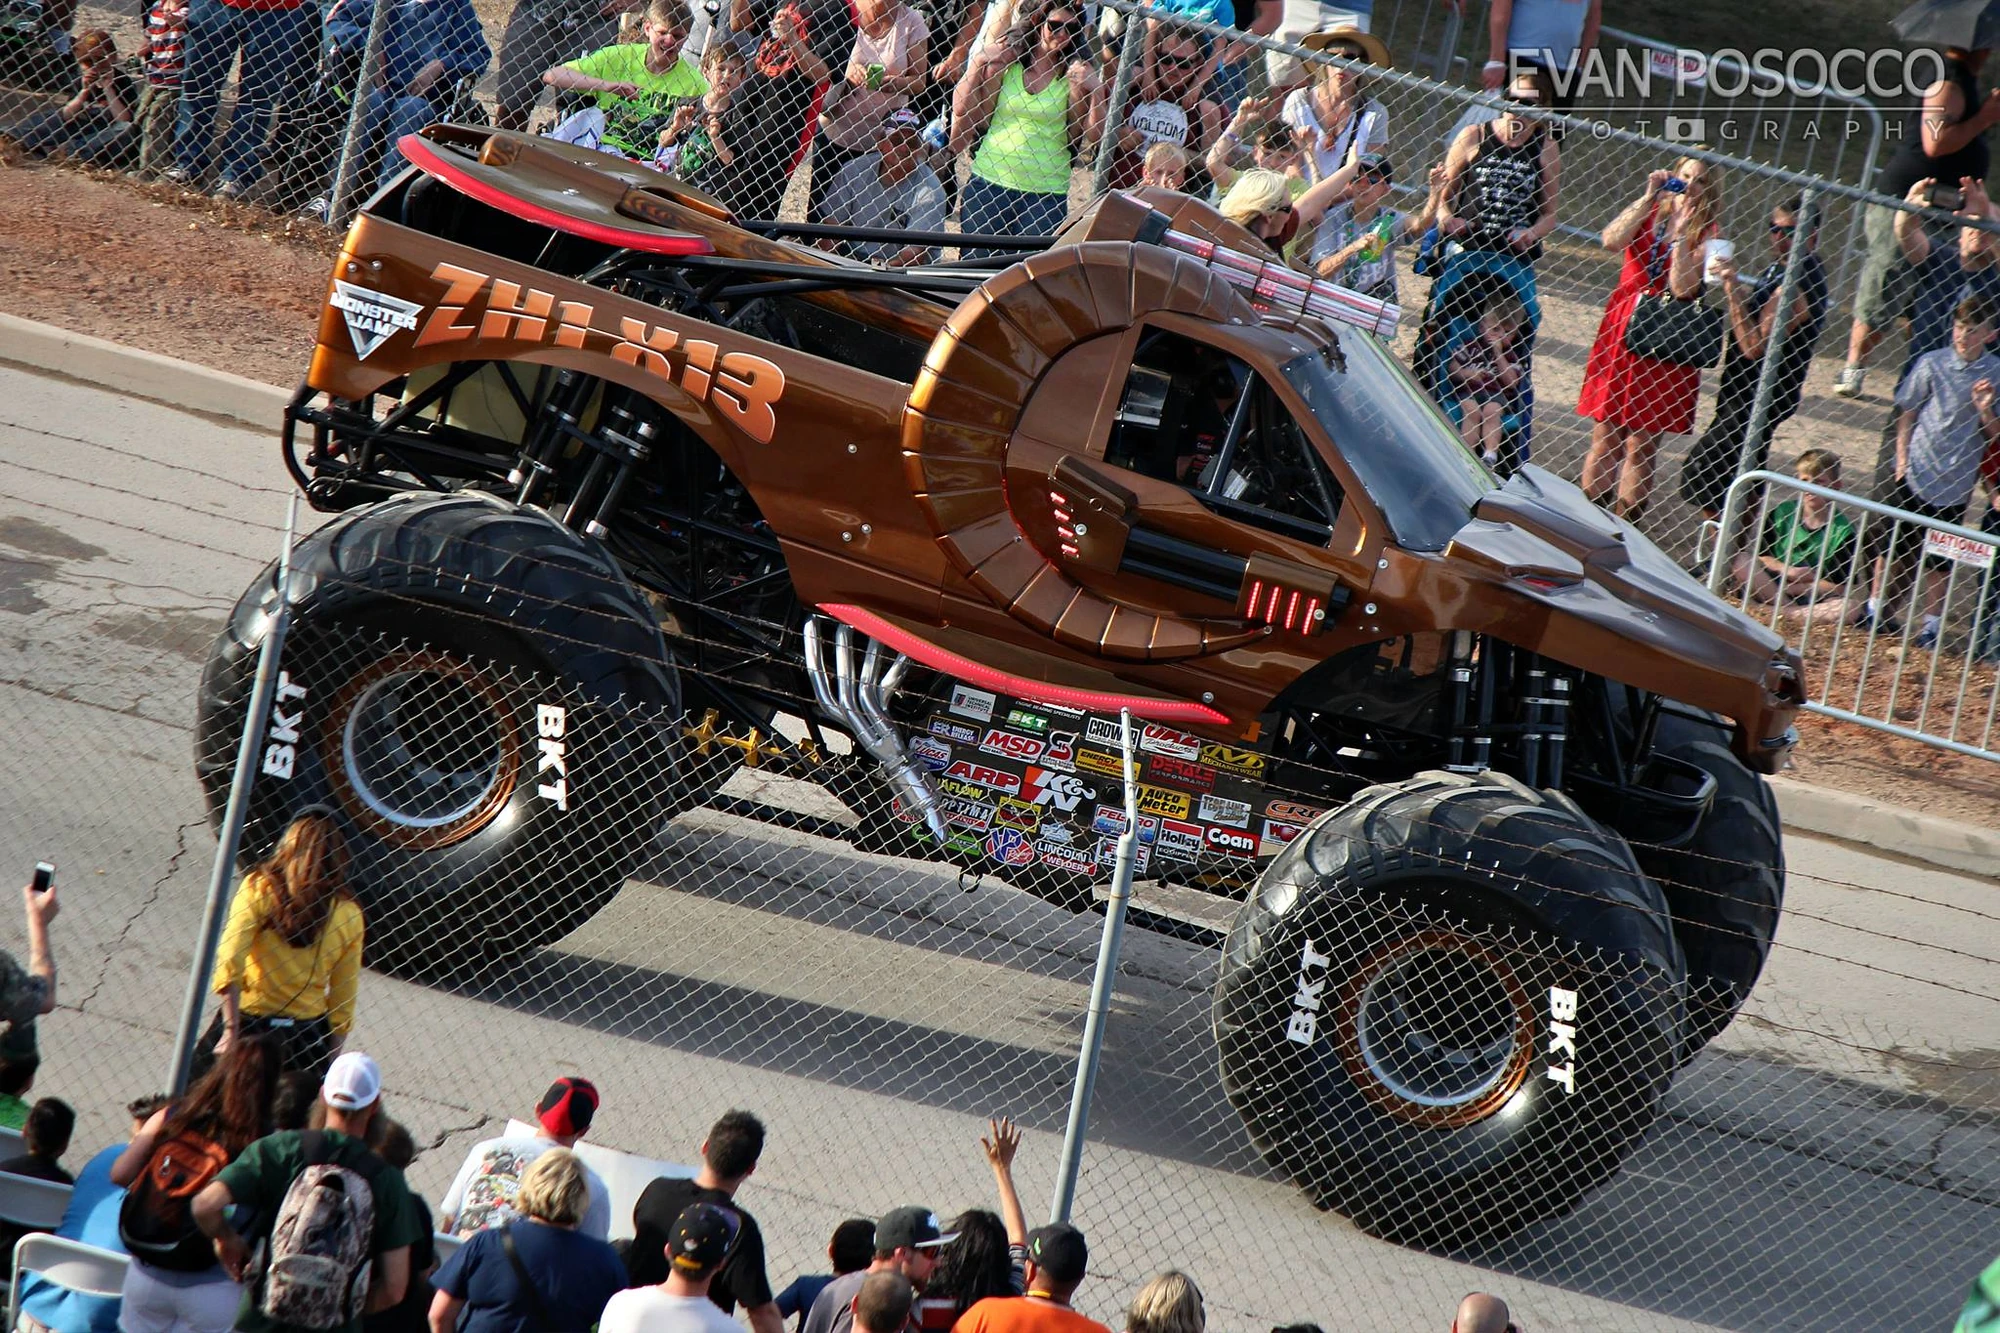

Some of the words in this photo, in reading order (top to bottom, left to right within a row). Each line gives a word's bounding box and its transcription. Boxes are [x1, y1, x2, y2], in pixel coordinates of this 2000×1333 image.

[1132, 116, 1185, 141] VOLCOM
[329, 292, 419, 331] MONSTER
[349, 316, 390, 337] JAM
[1930, 531, 1992, 557] NATIONAL
[263, 671, 308, 780] BKT
[1008, 711, 1047, 729] BKT
[1088, 719, 1139, 746] CROWR
[985, 731, 1042, 756] MSD
[537, 703, 567, 811] BKT
[1080, 751, 1118, 764] ENERGY
[948, 761, 1020, 788] ARP
[1161, 829, 1200, 851] Holley
[1208, 828, 1254, 850] Coan
[1037, 841, 1088, 863] LINCOLN
[1286, 939, 1331, 1046] BKT
[1547, 986, 1578, 1094] BKT
